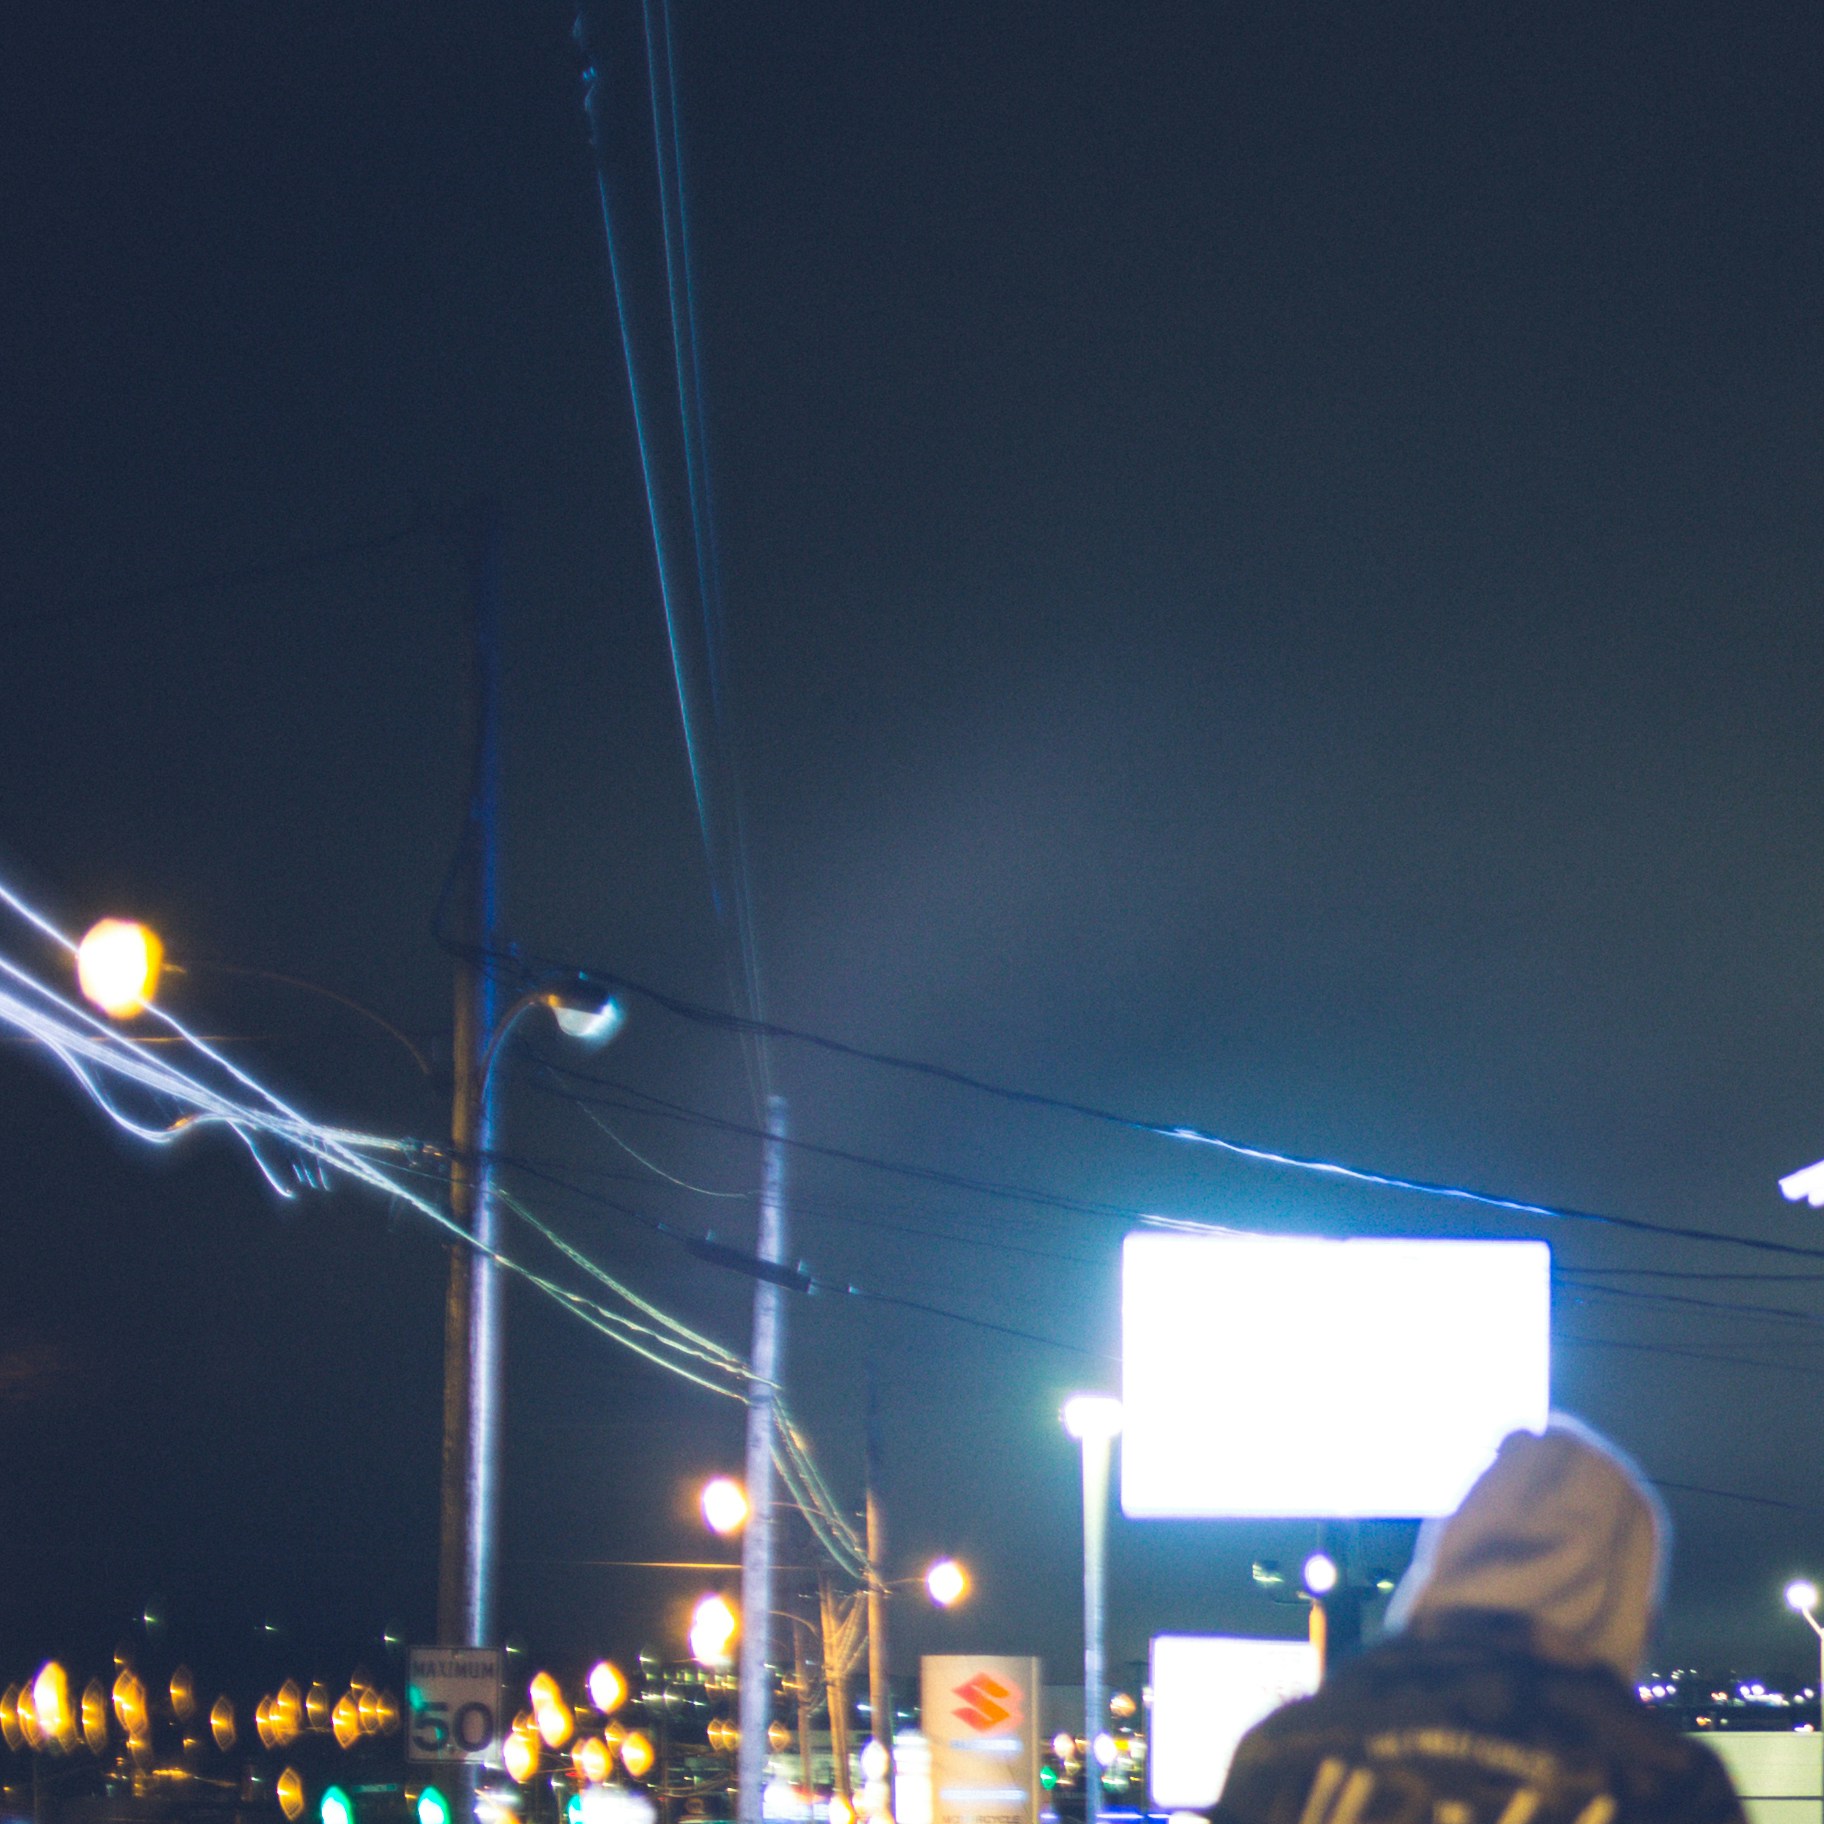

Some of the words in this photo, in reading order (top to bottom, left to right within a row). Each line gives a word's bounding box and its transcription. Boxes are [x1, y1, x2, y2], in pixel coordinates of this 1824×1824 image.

[413, 1661, 495, 1679] MAXIMUM
[413, 1701, 495, 1752] 50
[942, 1815, 1021, 1824] MORCYCLE
